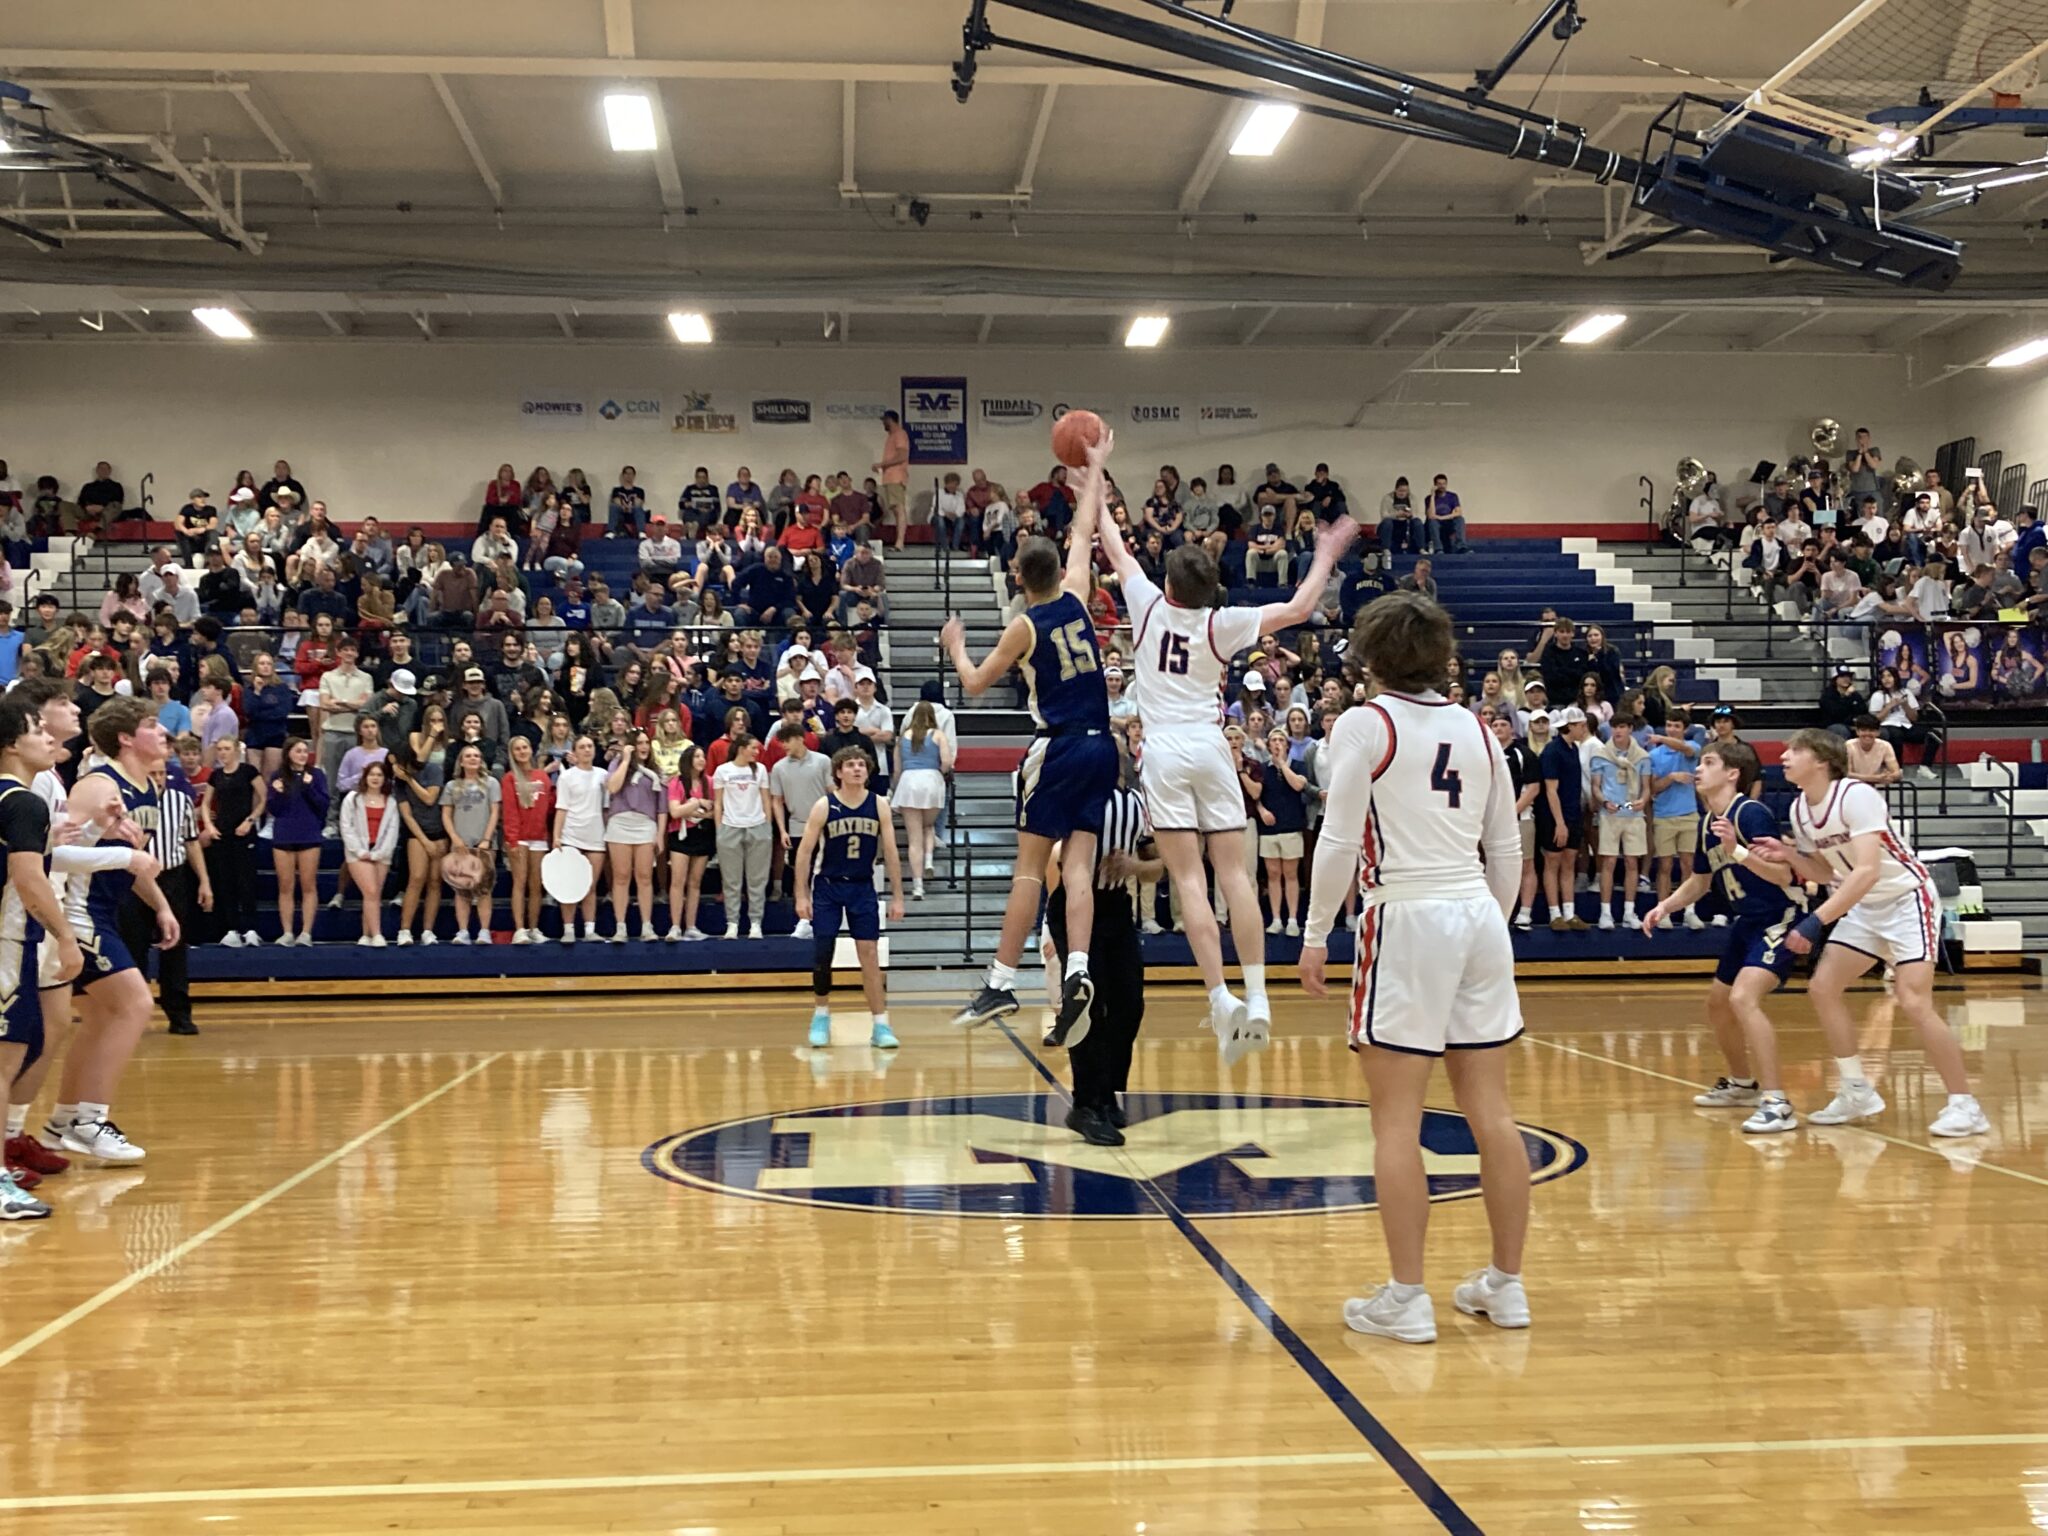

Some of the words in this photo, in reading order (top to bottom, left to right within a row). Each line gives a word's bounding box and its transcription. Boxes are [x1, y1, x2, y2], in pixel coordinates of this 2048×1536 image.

[535, 402, 583, 413] HOWIE'S
[626, 400, 660, 413] CGN
[755, 404, 807, 414] SHILLING
[917, 393, 952, 411] M
[911, 423, 939, 432] THANK
[940, 423, 957, 432] YOU
[1050, 618, 1097, 681] 15
[1158, 630, 1190, 675] 15
[1431, 742, 1462, 809] 4
[827, 816, 880, 839] HAYDEN
[847, 835, 861, 859] 2
